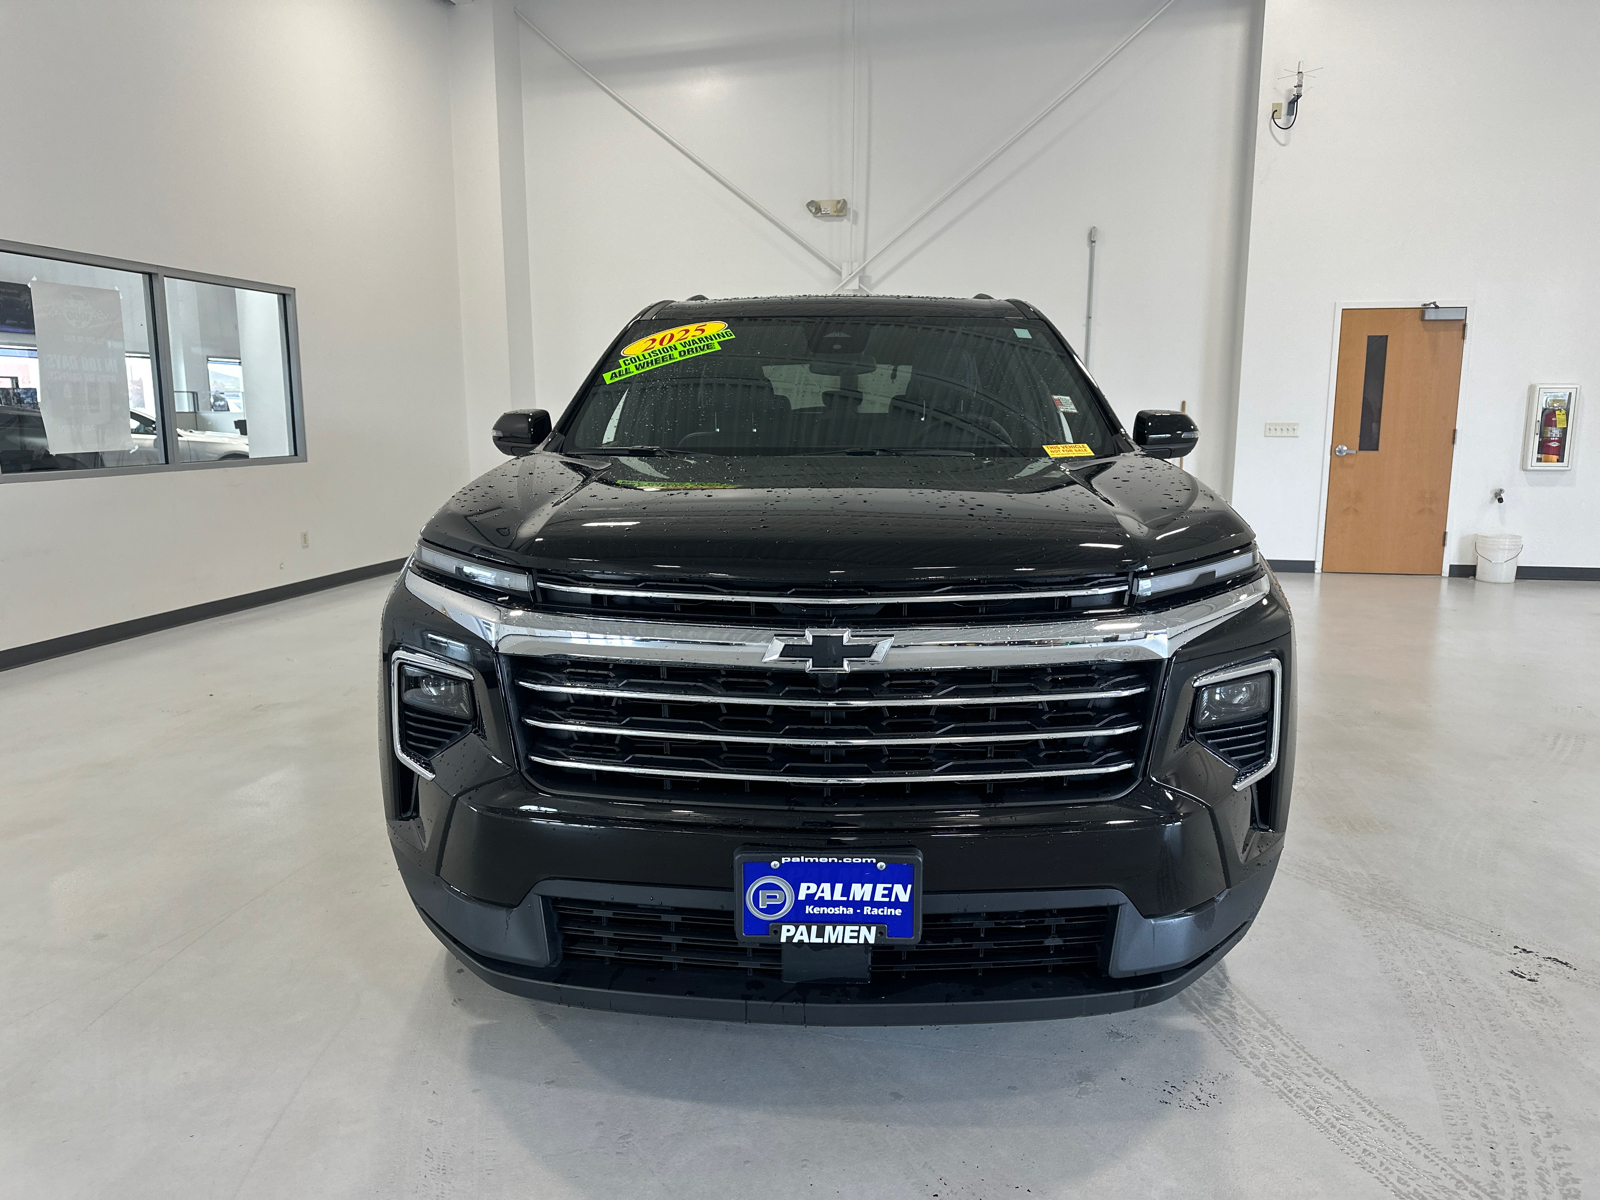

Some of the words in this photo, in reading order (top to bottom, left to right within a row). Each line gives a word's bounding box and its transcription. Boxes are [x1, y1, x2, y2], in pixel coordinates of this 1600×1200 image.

[641, 323, 708, 353] 2025
[622, 344, 678, 367] COLLISION
[679, 330, 734, 349] WARNING
[609, 367, 634, 380] ALL
[635, 353, 678, 371] WHEEL
[678, 342, 716, 357] DRIVE
[781, 855, 877, 864] palmen.com
[798, 882, 912, 902] PALMEN
[805, 905, 854, 915] Kenosha
[863, 906, 903, 916] Racine
[780, 924, 877, 944] PALMEN
